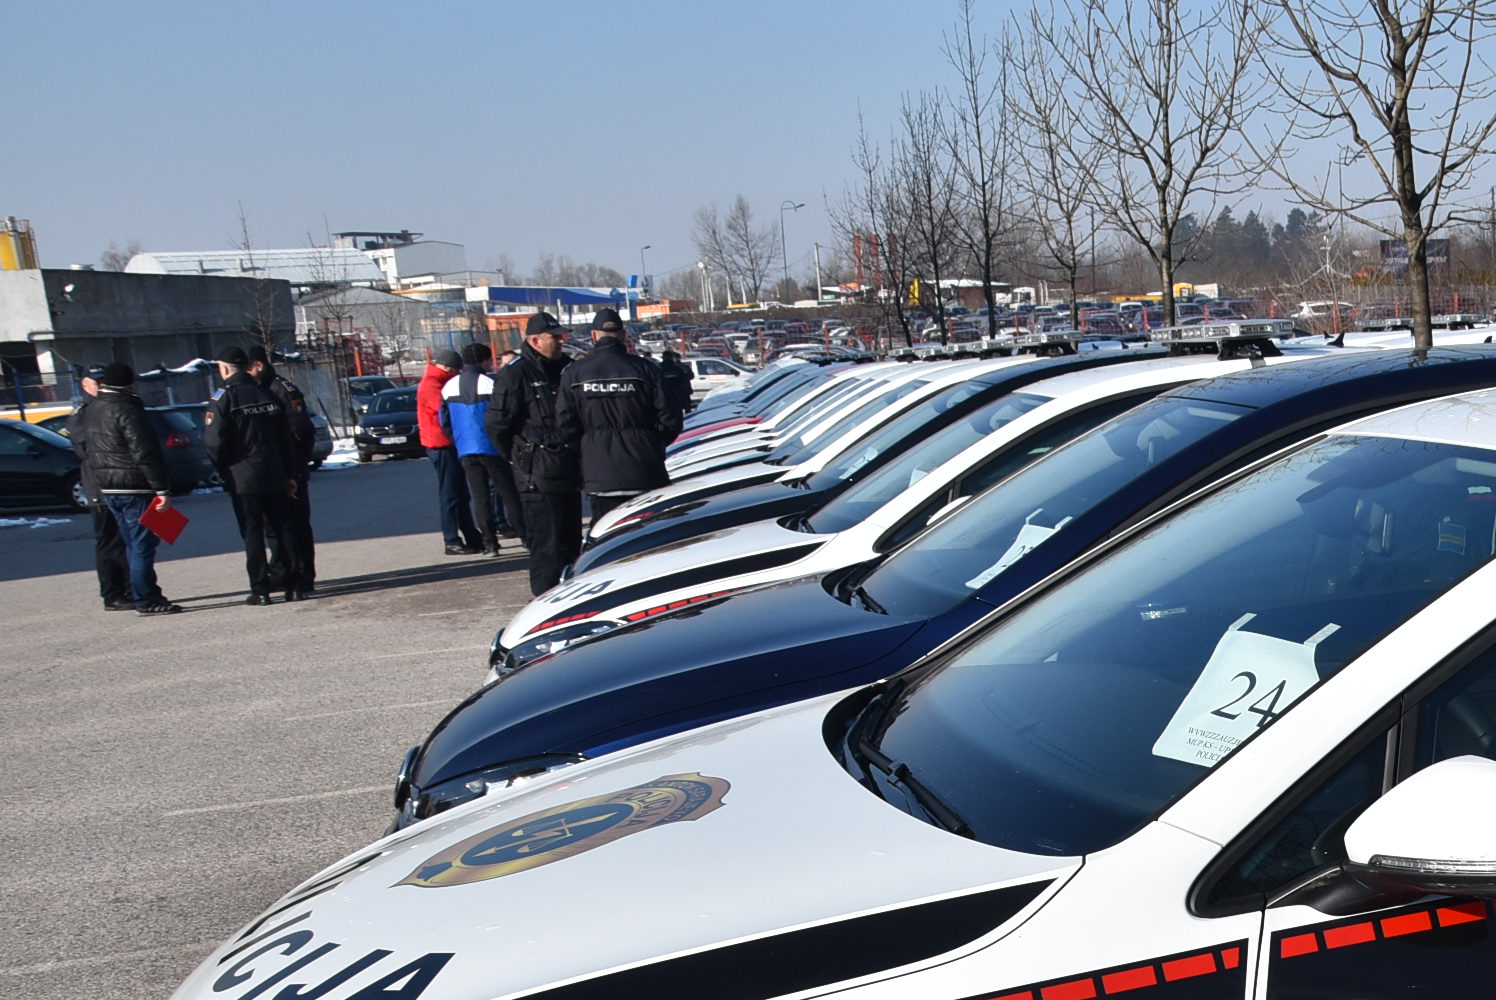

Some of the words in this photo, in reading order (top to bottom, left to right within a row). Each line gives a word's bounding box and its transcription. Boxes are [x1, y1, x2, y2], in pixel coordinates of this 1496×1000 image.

[583, 382, 637, 393] POLICIJA
[1210, 671, 1287, 728] 24
[1186, 737, 1203, 747] MUP
[1203, 740, 1214, 749] KS
[1218, 744, 1234, 754] UP
[1195, 750, 1224, 761] POLICI
